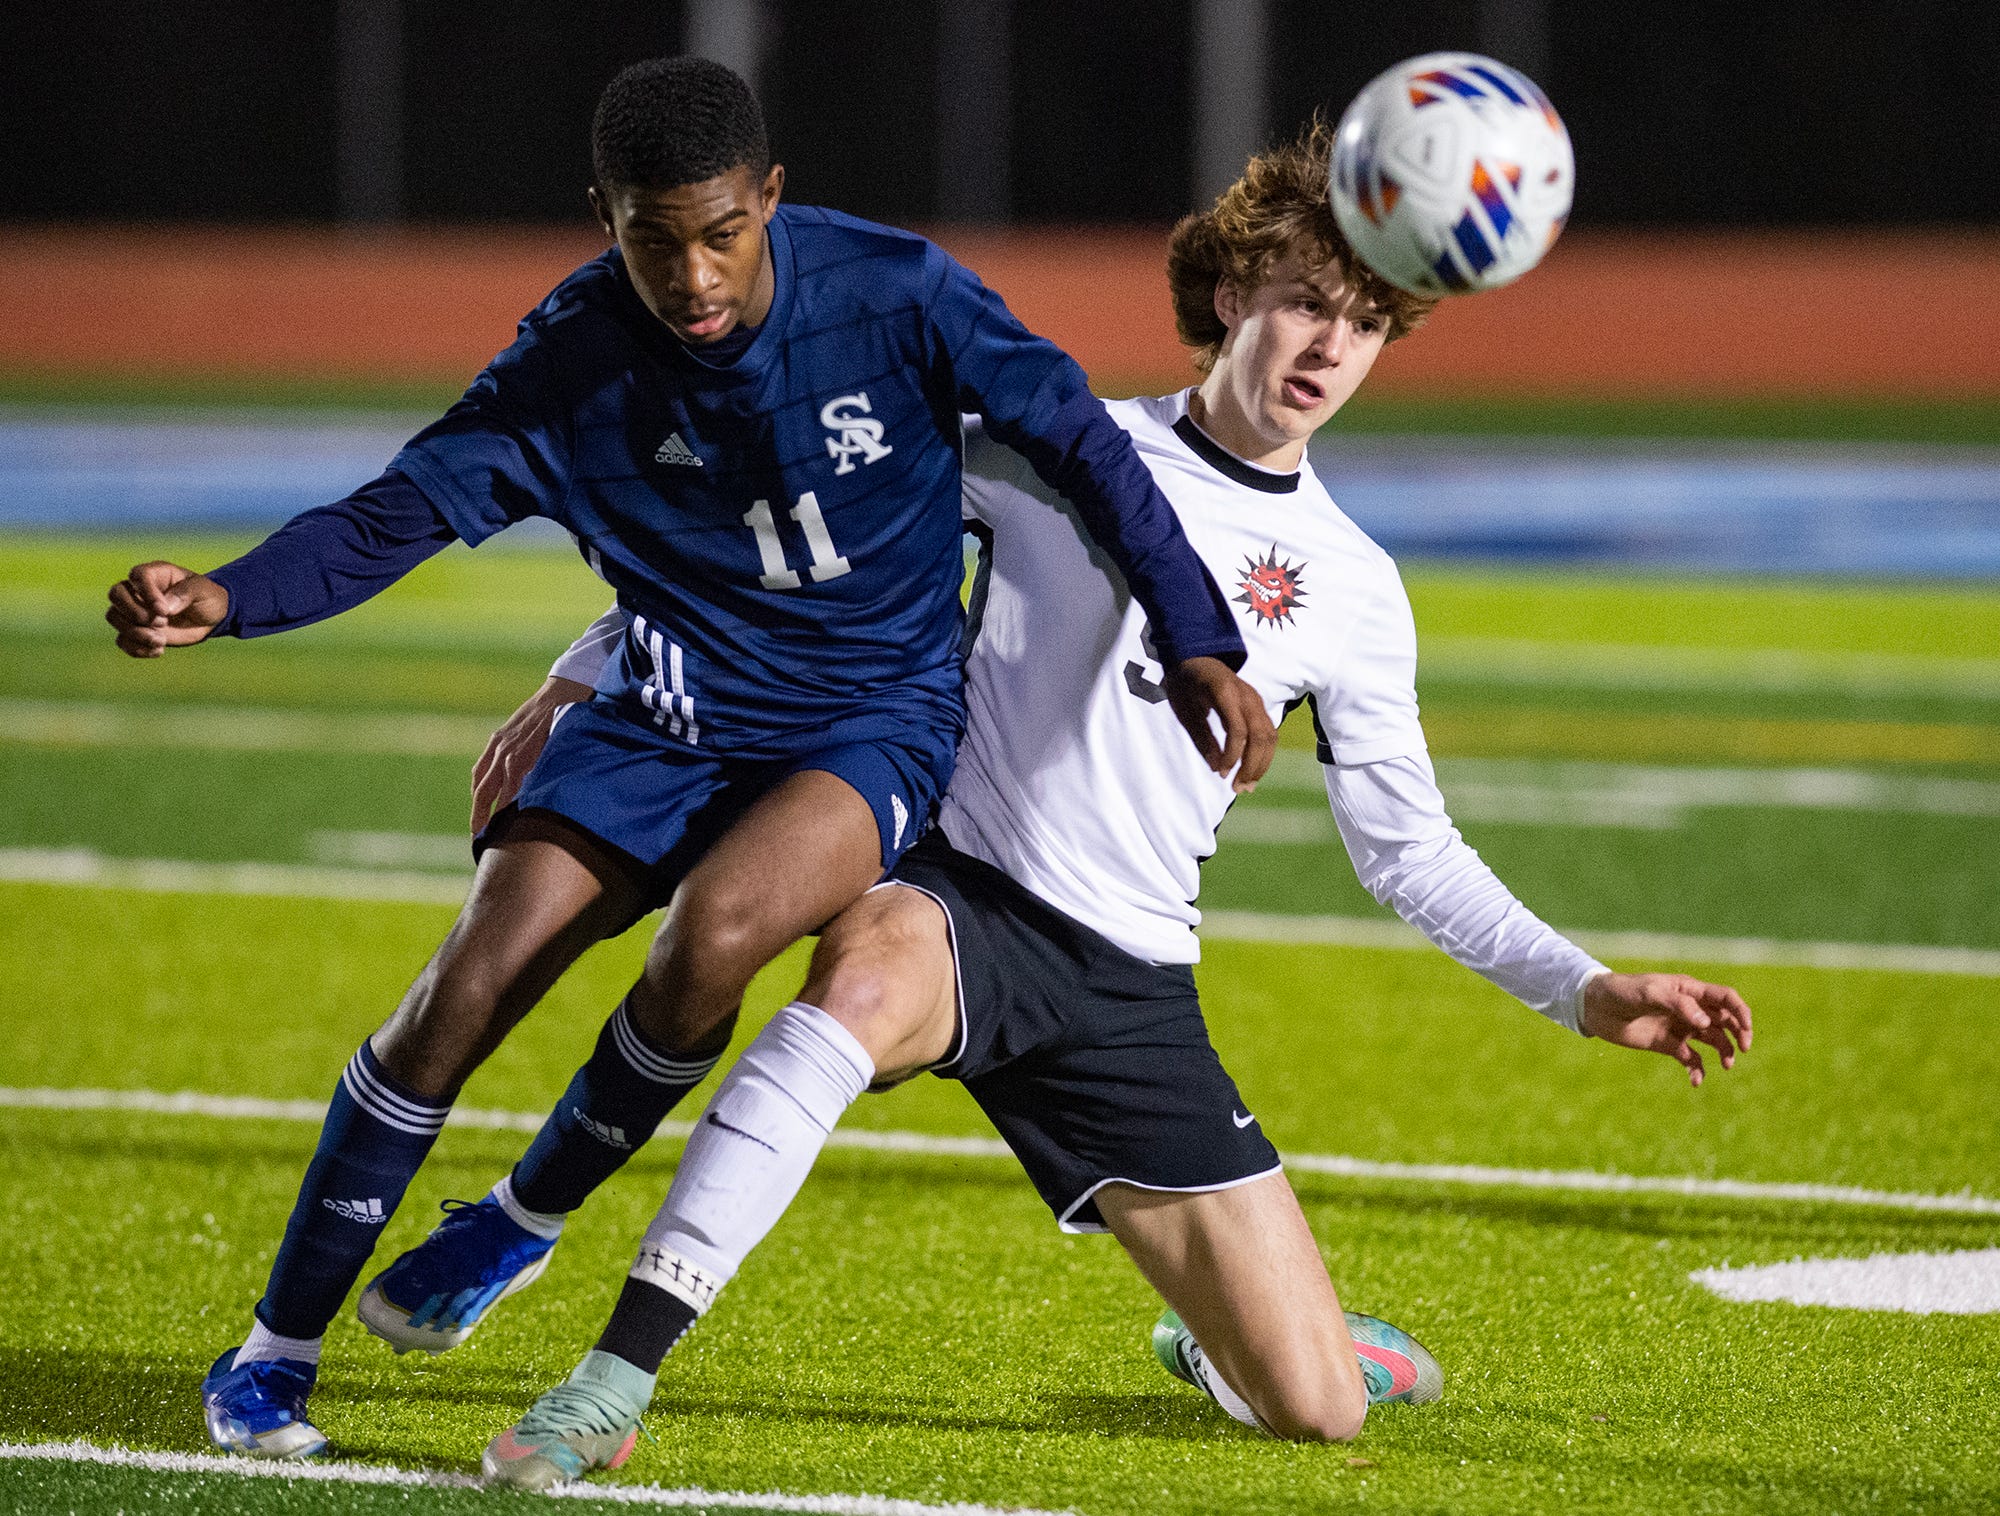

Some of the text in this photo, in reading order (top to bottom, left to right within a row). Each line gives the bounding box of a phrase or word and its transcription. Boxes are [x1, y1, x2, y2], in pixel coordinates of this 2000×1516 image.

[654, 449, 704, 467] adidas
[743, 491, 852, 590] 11
[573, 1107, 633, 1150] adidas
[323, 1198, 387, 1224] adidas
